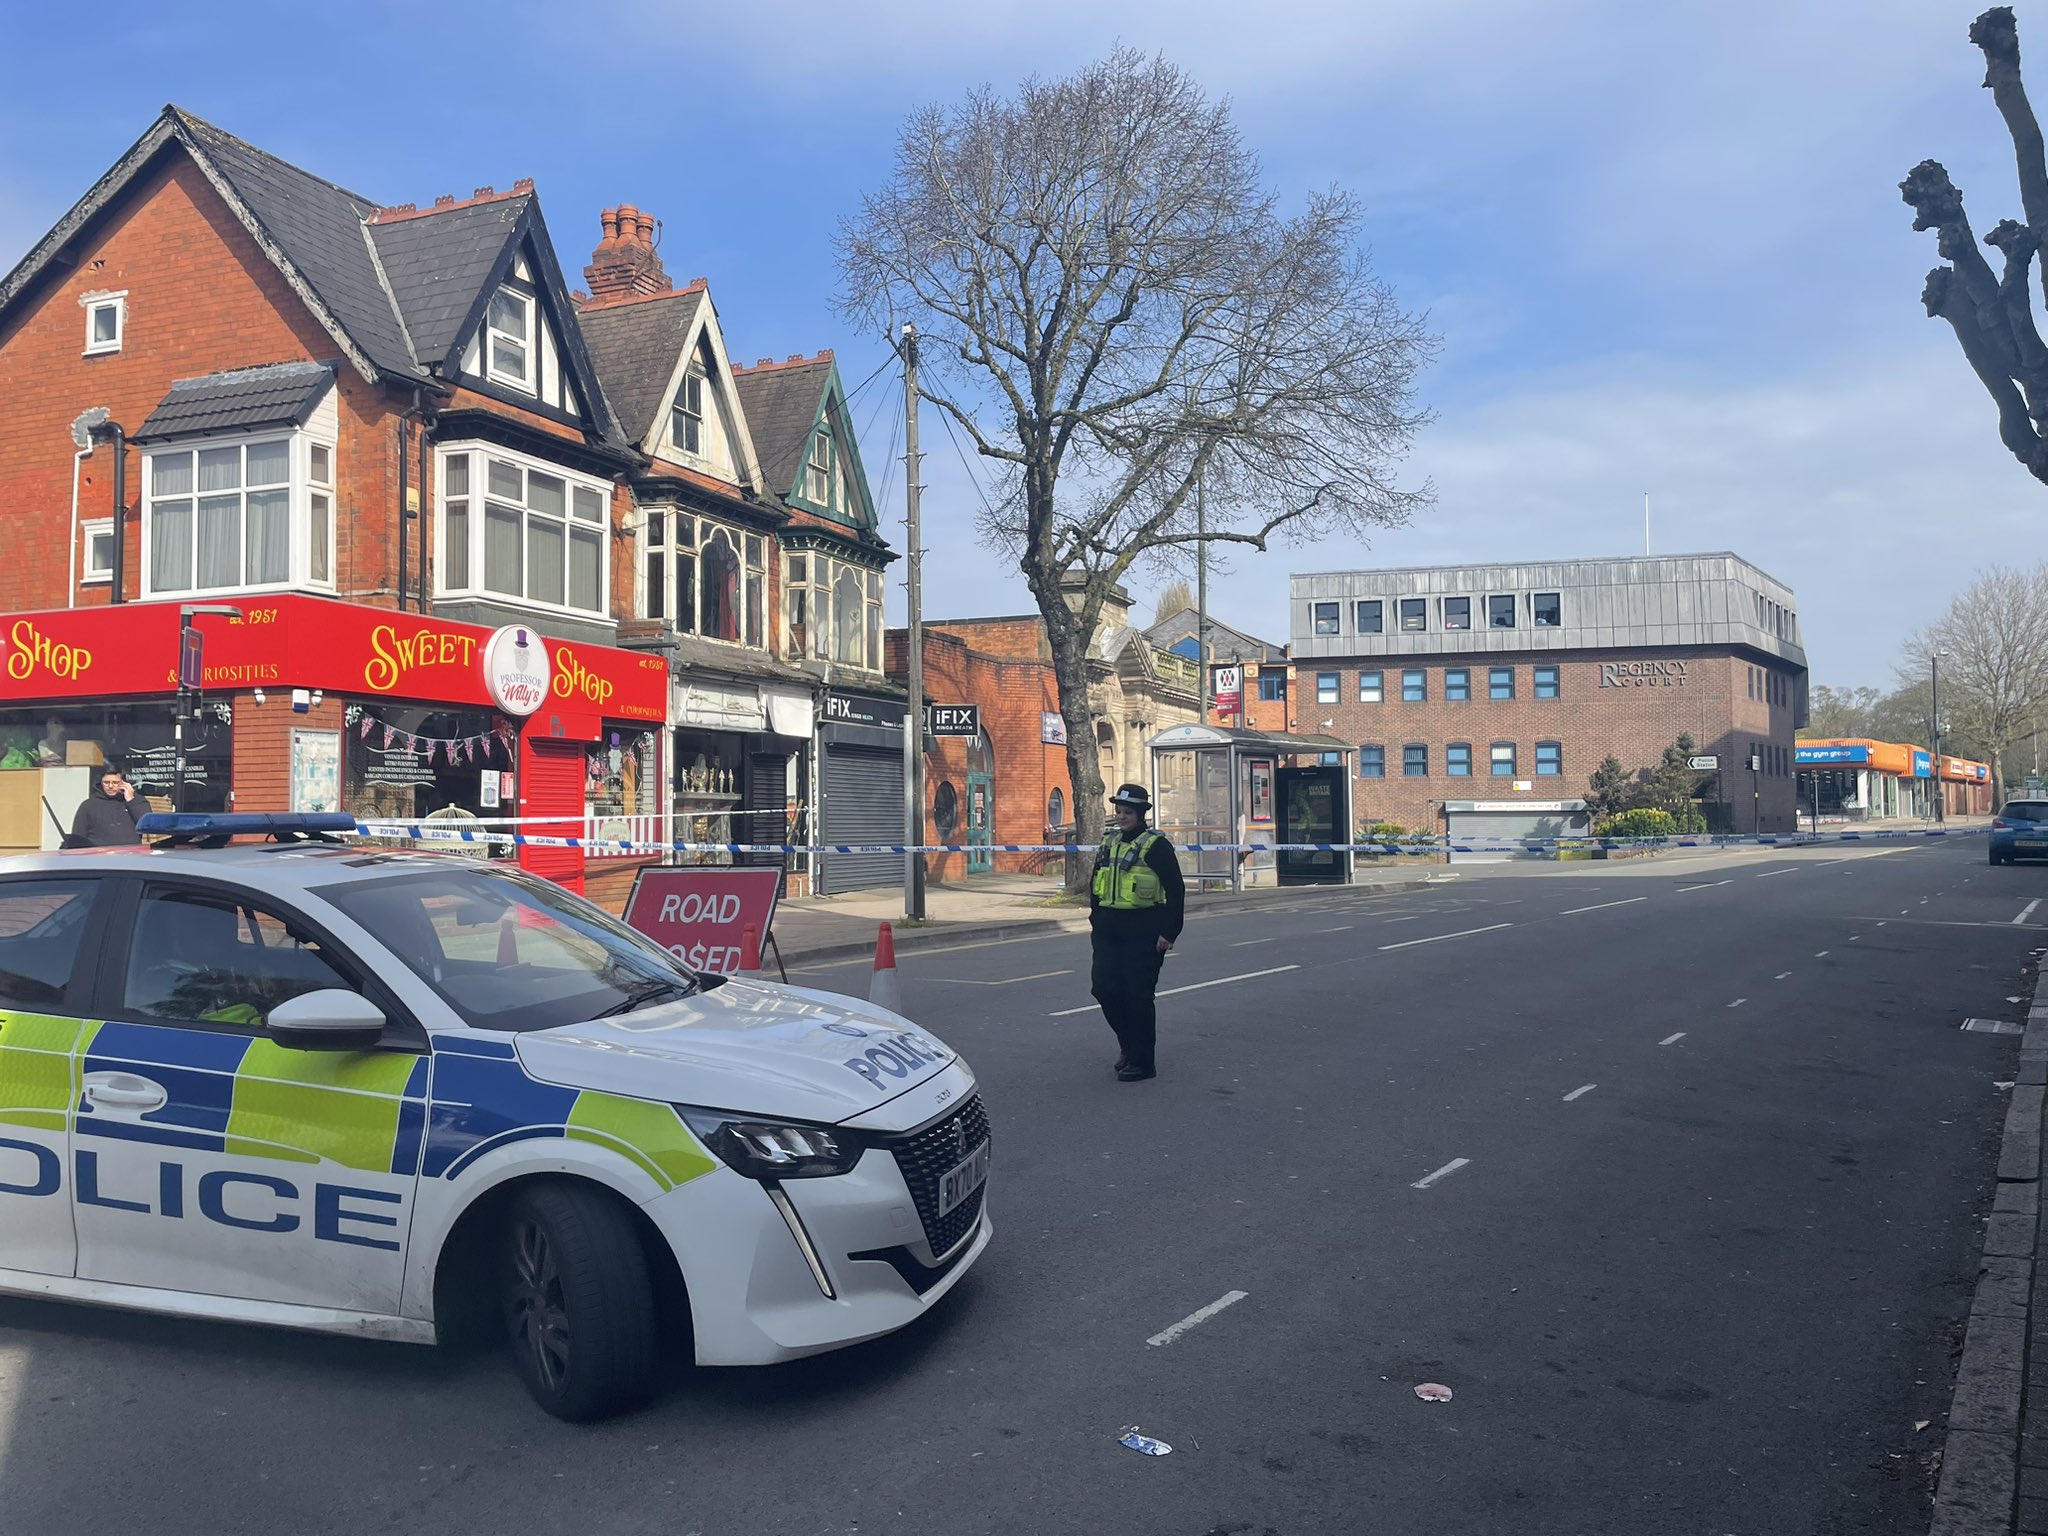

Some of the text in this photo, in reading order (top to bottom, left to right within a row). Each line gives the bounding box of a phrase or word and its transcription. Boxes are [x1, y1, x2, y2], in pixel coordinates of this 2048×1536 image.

[249, 608, 278, 624] 1951
[364, 625, 476, 690] SWEET
[167, 664, 279, 682] & RIOSITIES
[500, 673, 542, 688] PROFESSOR
[1599, 661, 1688, 688] REGENCY
[1621, 676, 1687, 688] COURT
[502, 683, 540, 707] Willy's
[826, 697, 851, 718] iFIX
[936, 709, 972, 724] iFIX
[1812, 751, 1829, 759] gym
[379, 828, 400, 836] POLICE
[431, 831, 451, 839] POLICE
[482, 833, 504, 841] POLICE
[658, 893, 741, 924] ROAD
[667, 943, 742, 976] OSED
[843, 1032, 945, 1092] POLICE
[0, 1138, 403, 1252] OLICE
